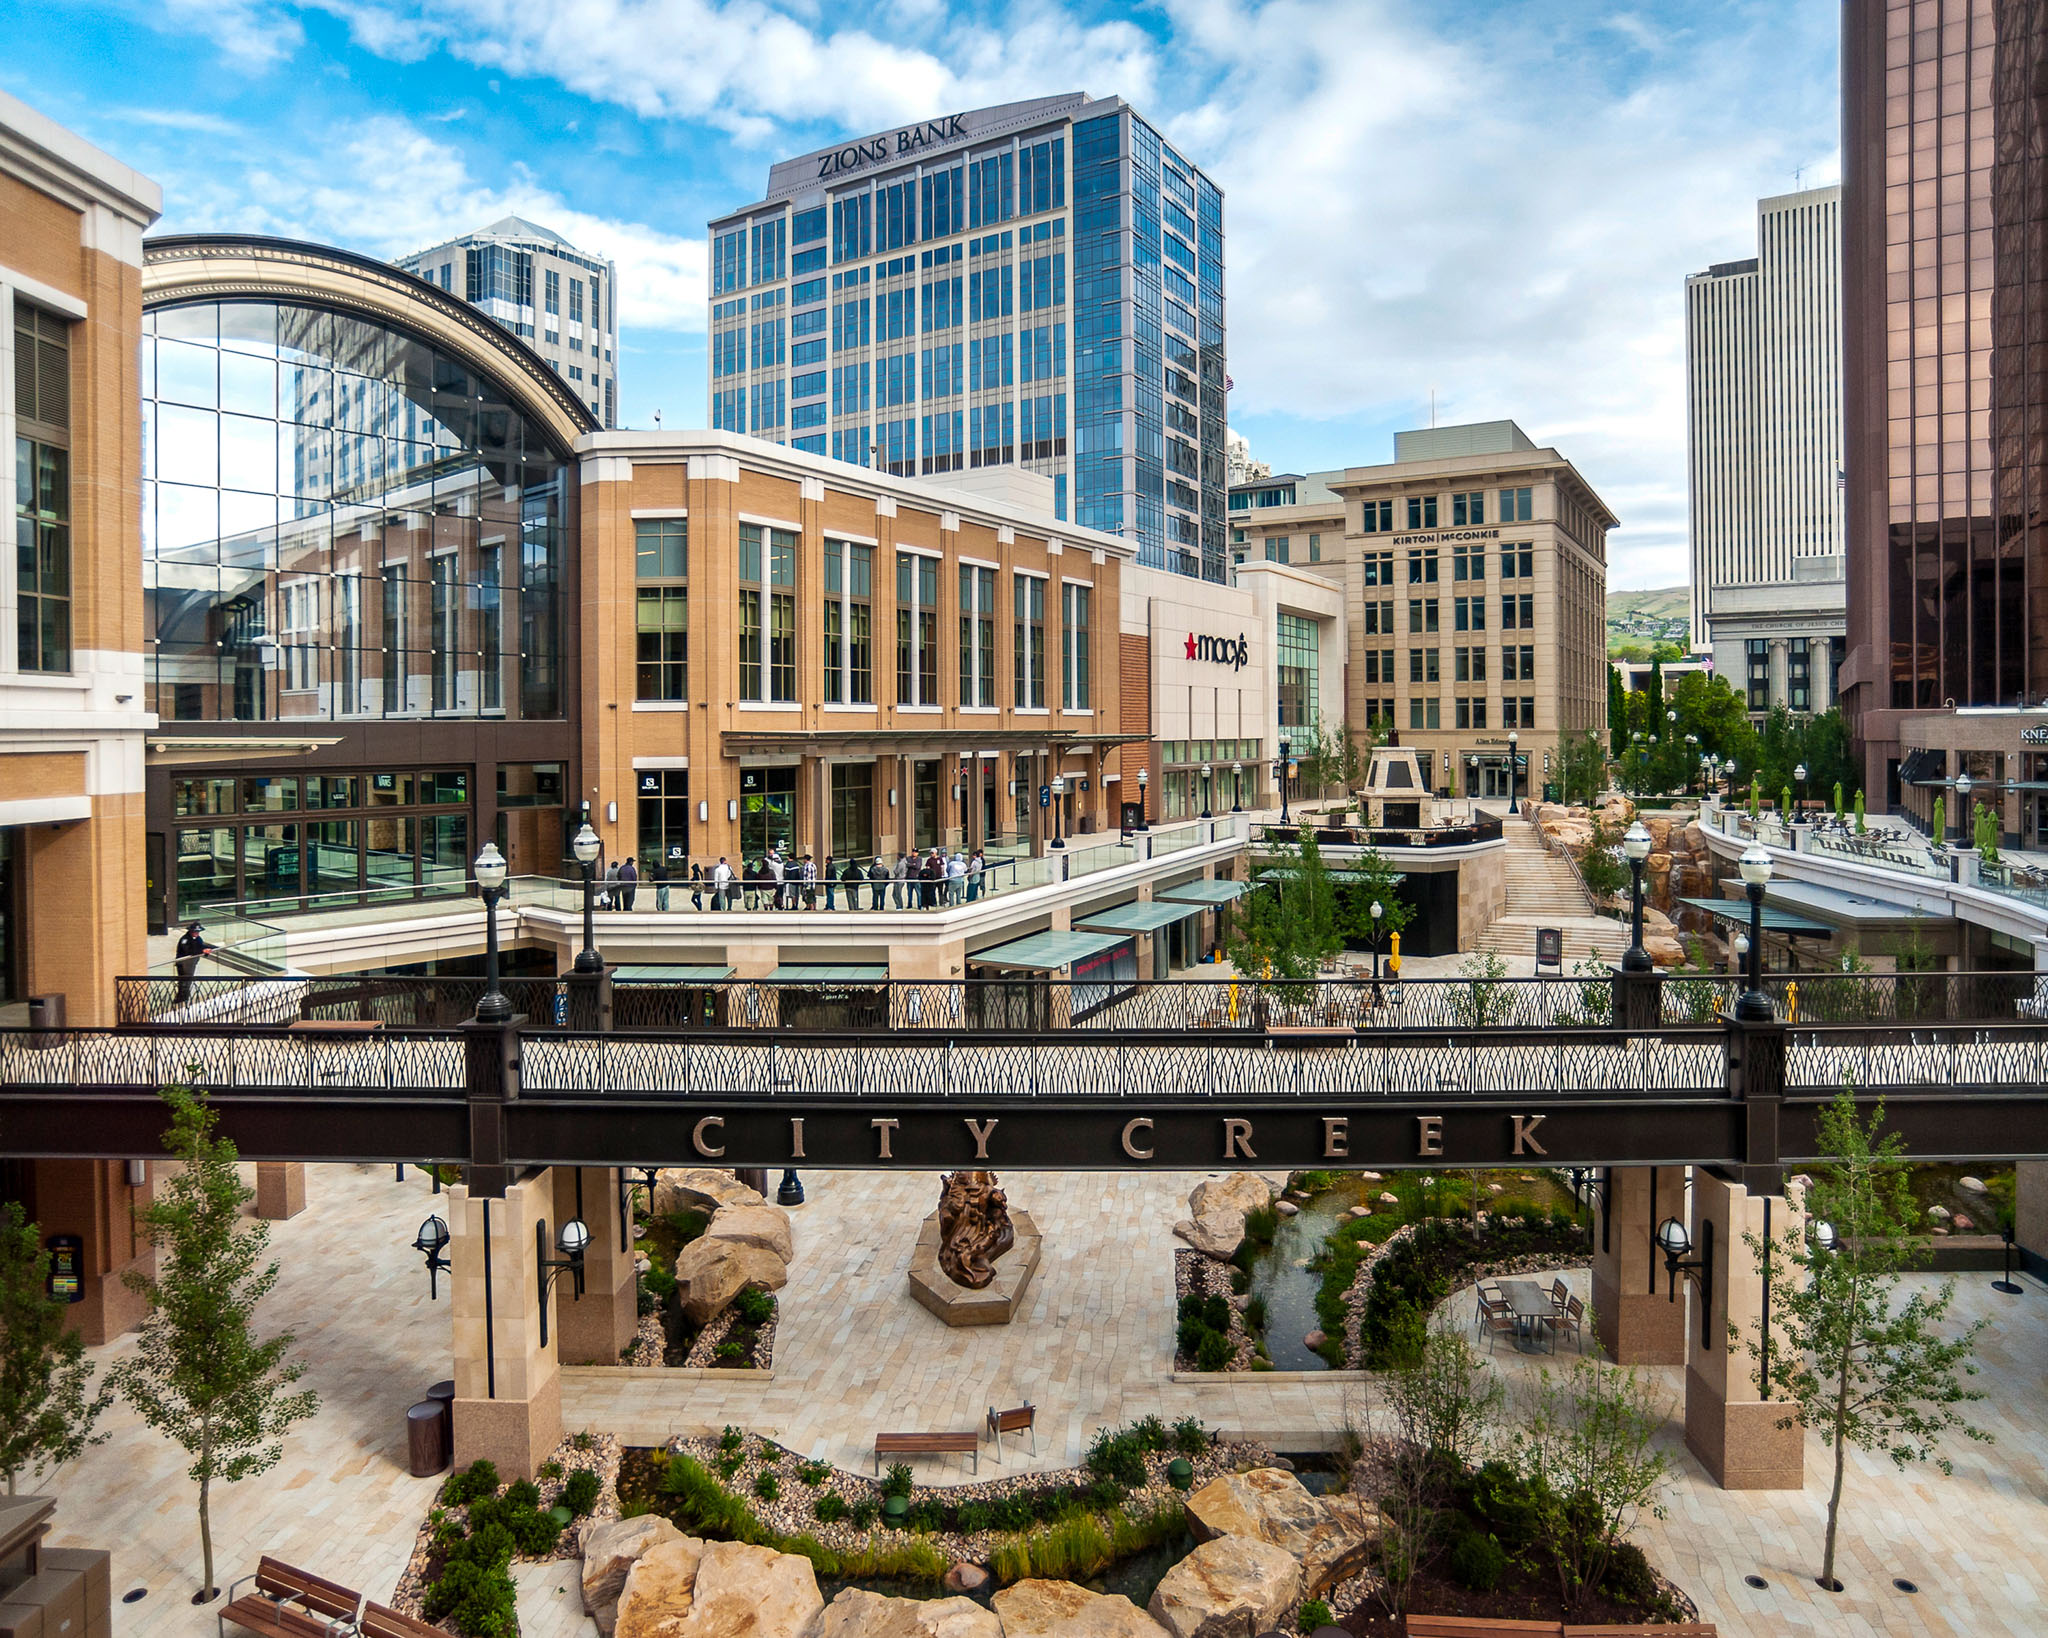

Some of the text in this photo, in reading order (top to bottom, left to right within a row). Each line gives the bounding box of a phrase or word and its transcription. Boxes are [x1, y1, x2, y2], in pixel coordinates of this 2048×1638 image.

[818, 112, 967, 178] ZIONS BANK
[1393, 534, 1435, 545] KIRTON
[1198, 632, 1247, 672] macy's
[2021, 729, 2048, 739] KNE
[1713, 914, 1729, 927] FOOD
[692, 1114, 1548, 1159] CITY CREEK
